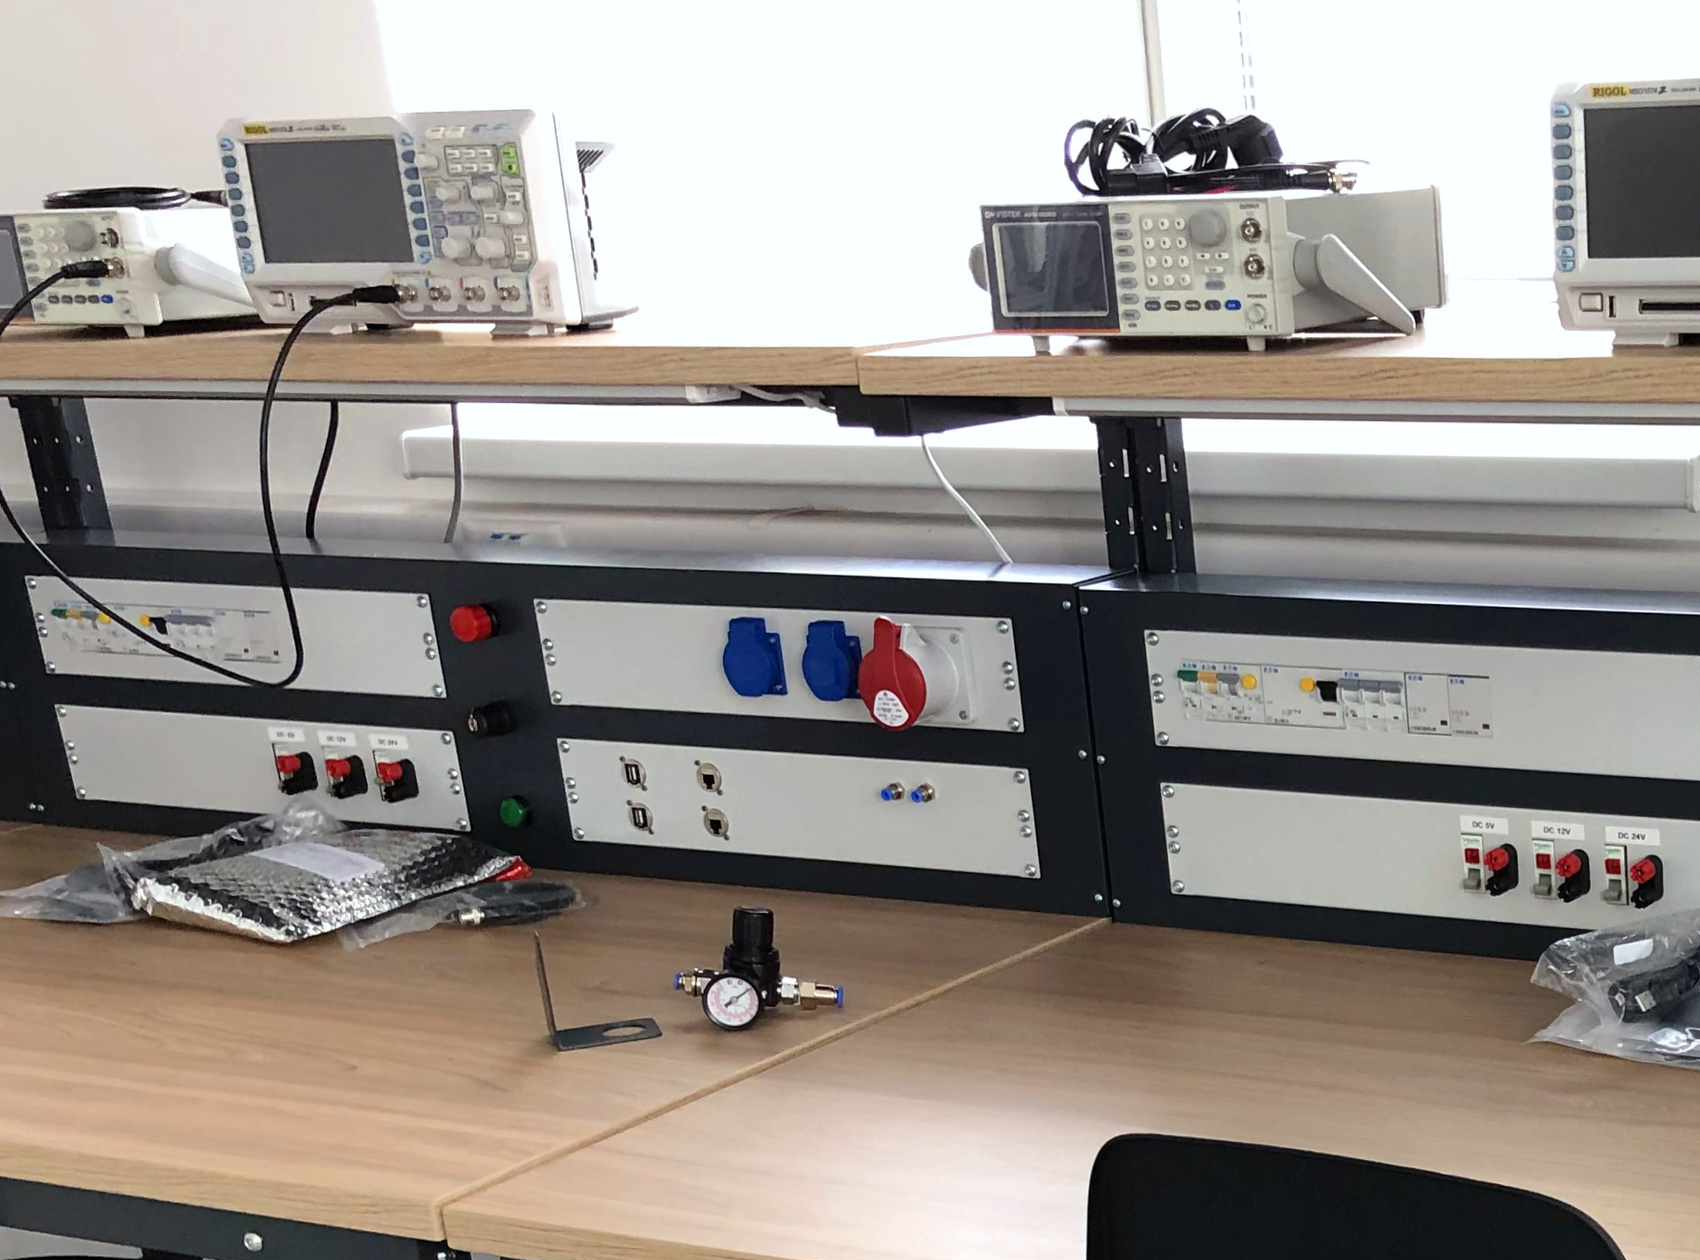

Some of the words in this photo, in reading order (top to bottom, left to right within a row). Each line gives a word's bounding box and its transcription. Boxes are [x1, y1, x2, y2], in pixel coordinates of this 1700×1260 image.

[1592, 86, 1627, 98] RIGOL
[1472, 821, 1484, 829] DC
[1485, 822, 1495, 830] 5V
[1543, 826, 1555, 834] DC
[1557, 827, 1571, 836] 12V
[1617, 831, 1629, 840] DC
[1631, 832, 1646, 841] 24V
